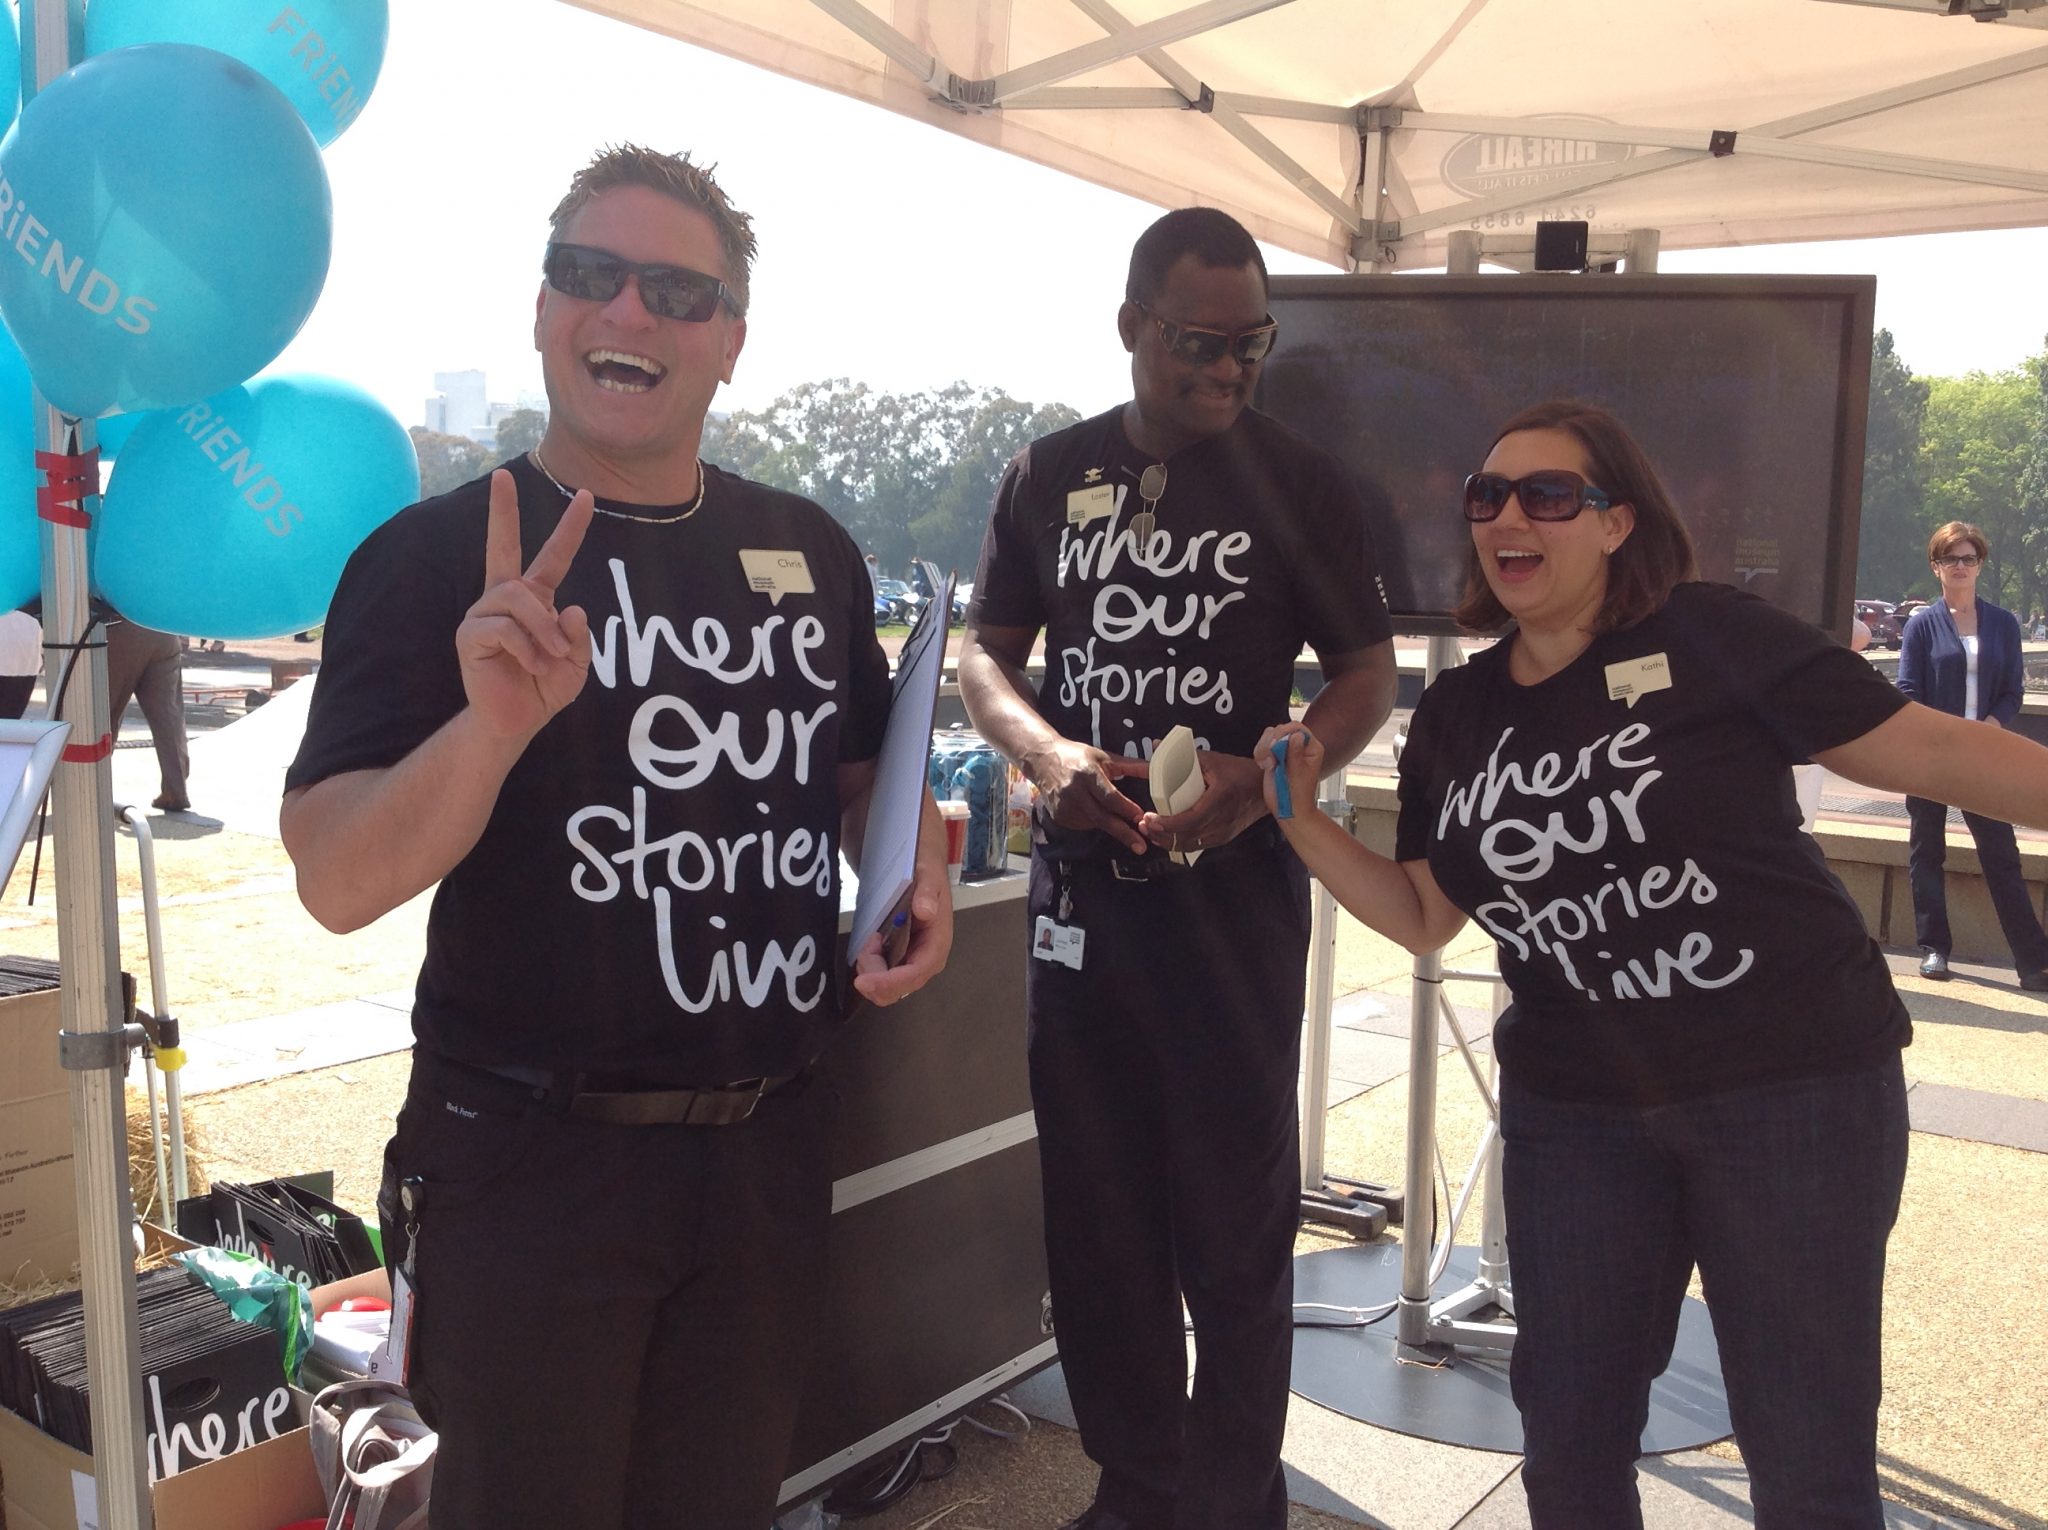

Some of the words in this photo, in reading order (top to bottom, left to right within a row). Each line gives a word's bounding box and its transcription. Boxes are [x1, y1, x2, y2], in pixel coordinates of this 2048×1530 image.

[0, 166, 158, 335] RiENDS
[176, 400, 305, 538] RiENDS
[777, 558, 803, 569] Chris
[1640, 660, 1665, 672] Kathi
